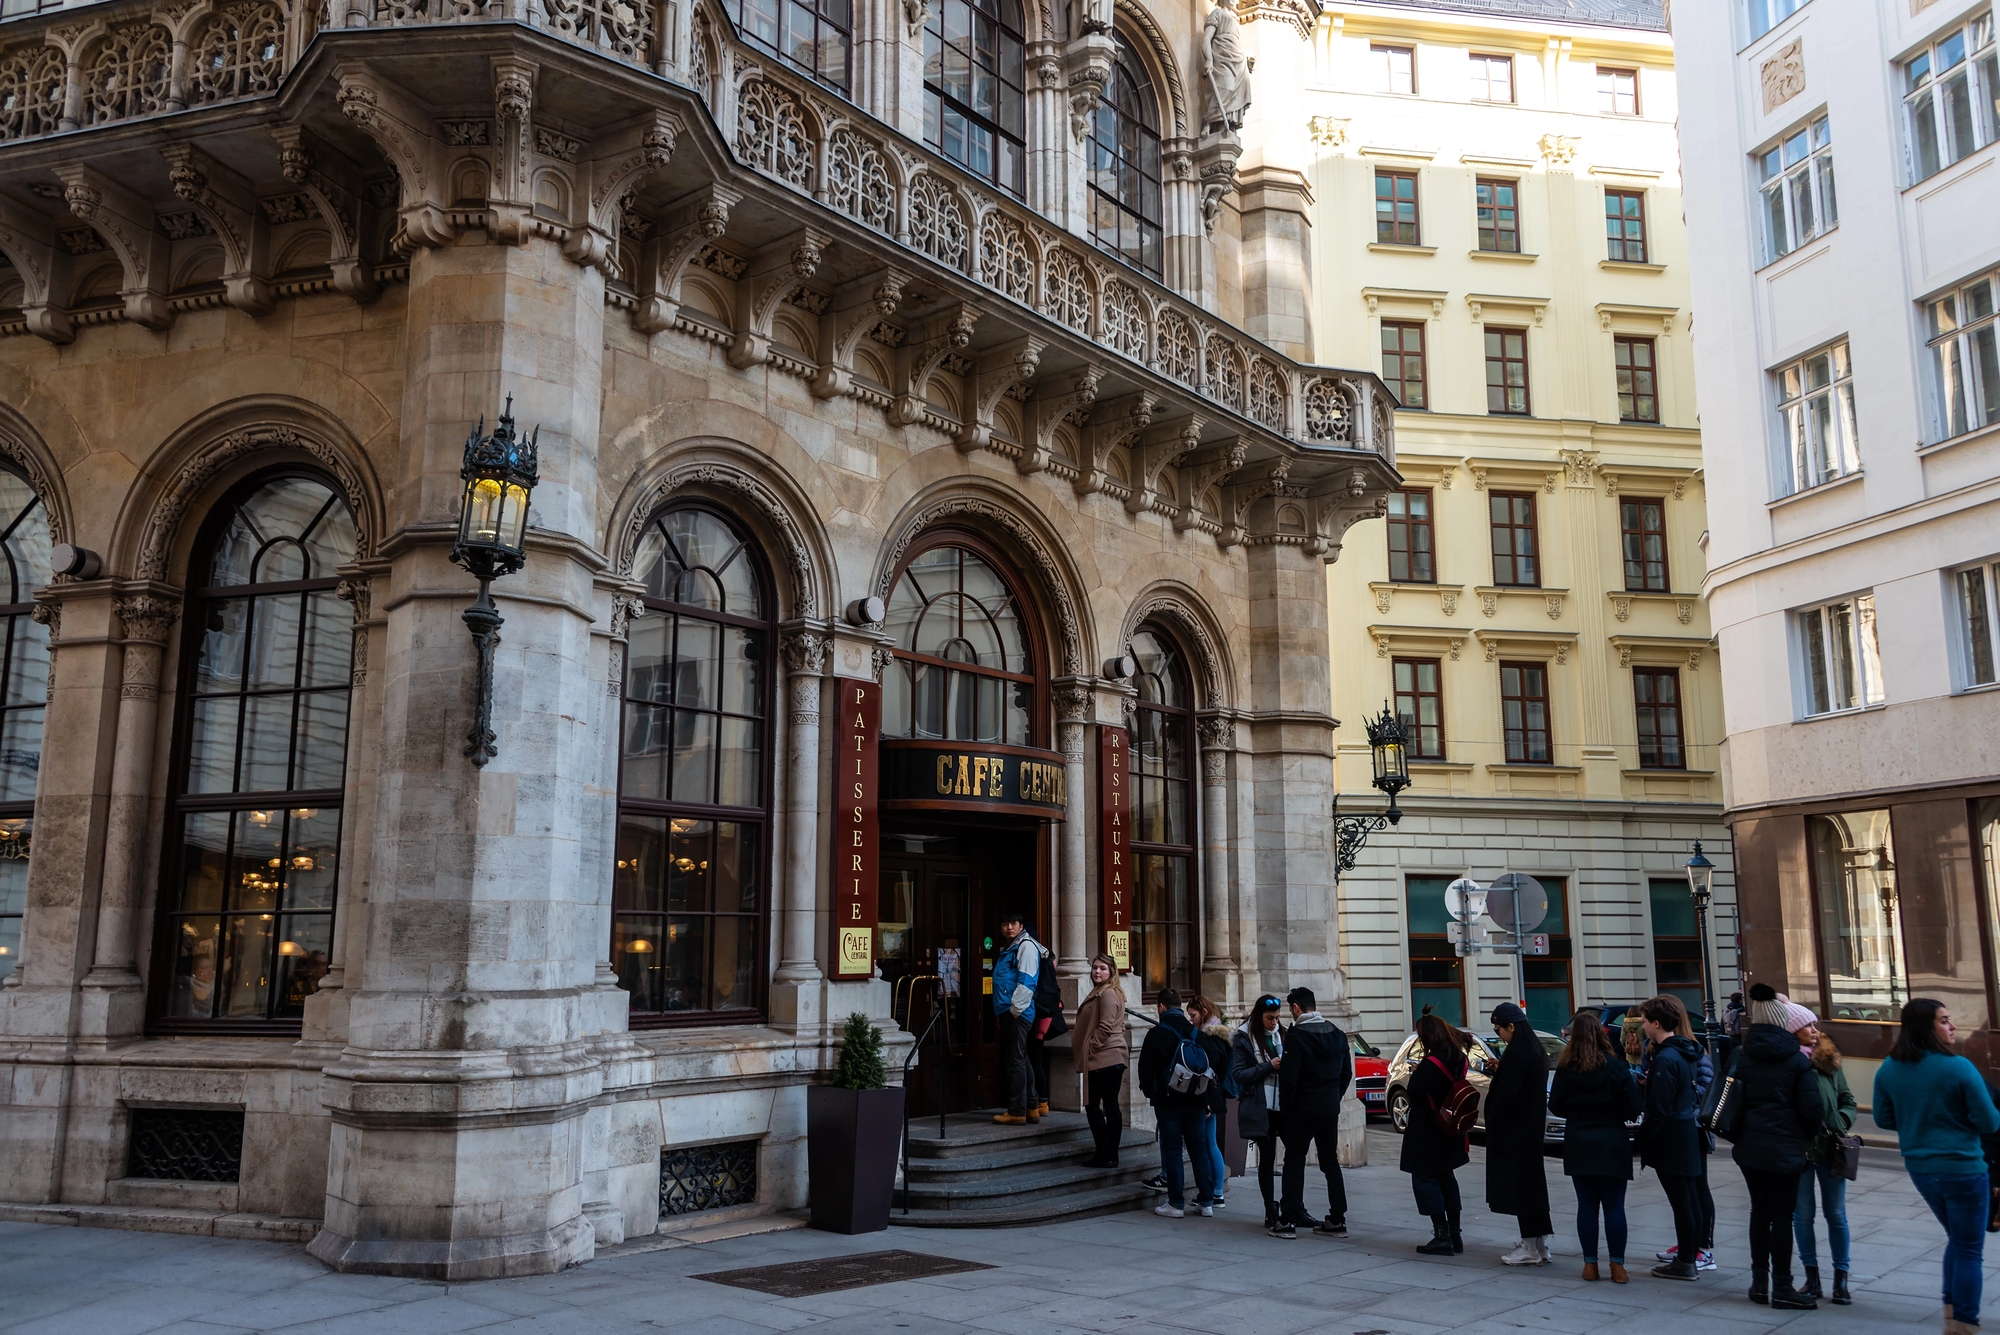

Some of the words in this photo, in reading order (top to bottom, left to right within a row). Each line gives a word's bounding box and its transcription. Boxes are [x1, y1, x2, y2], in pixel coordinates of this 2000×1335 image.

[936, 755, 1004, 798] CAFE
[851, 688, 866, 920] PATISSERIE
[1112, 733, 1122, 925] RESTAURANT
[843, 932, 869, 964] CAFE
[851, 951, 868, 960] CENTRAL
[1109, 934, 1127, 960] CAFE
